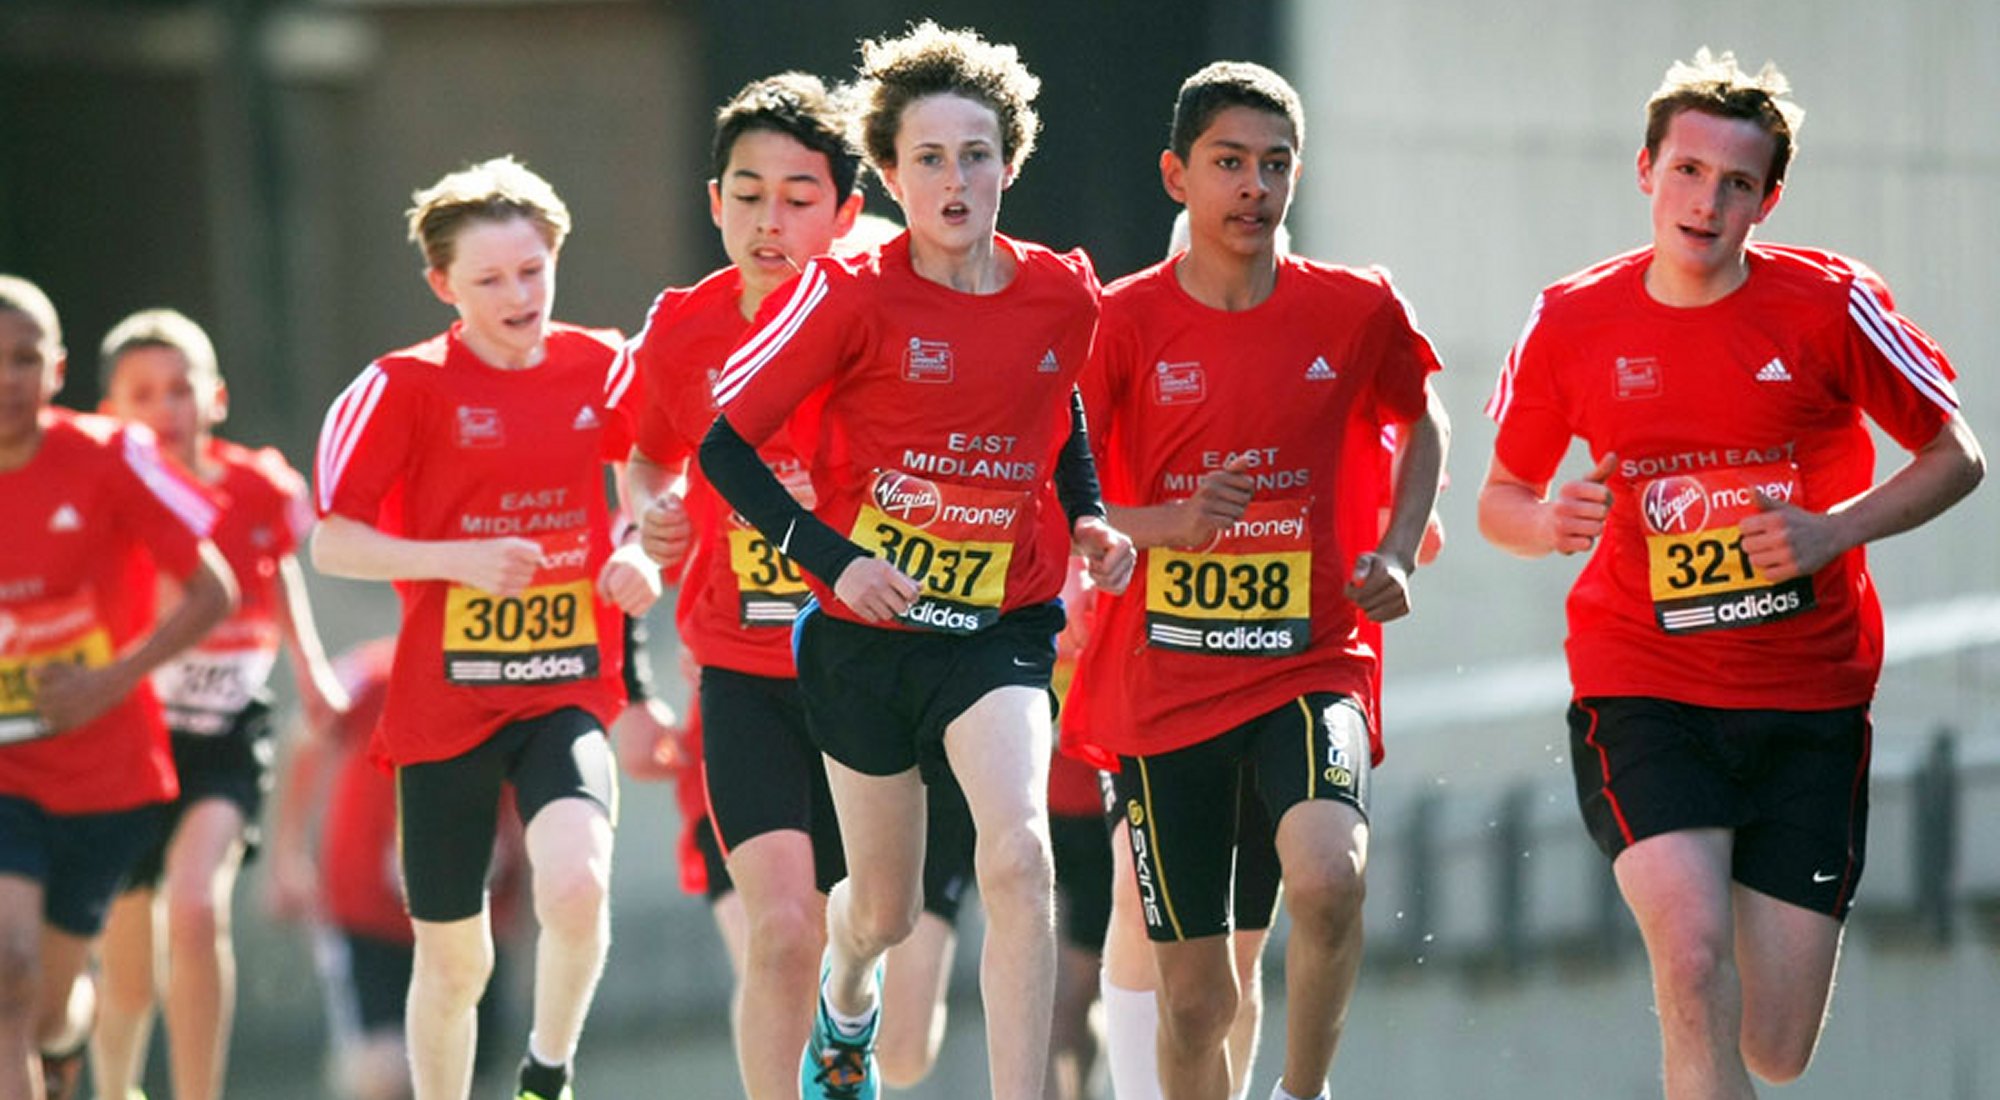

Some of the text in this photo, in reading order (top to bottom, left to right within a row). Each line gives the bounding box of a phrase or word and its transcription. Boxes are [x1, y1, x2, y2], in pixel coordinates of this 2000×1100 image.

[948, 432, 1018, 454] EAST
[1203, 447, 1280, 469] EAST
[902, 449, 1037, 481] MIDLANDS
[1621, 441, 1797, 478] SOUTH EAST
[1164, 468, 1310, 491] MINDS
[501, 487, 568, 511] EAST
[876, 474, 1017, 530] Virgin money
[1648, 480, 1794, 532] Virgin moey
[541, 546, 590, 571] oney
[876, 522, 993, 597] 3037
[1164, 560, 1290, 611] 3038
[463, 592, 577, 642] 3039
[1718, 591, 1800, 622] adidas
[1205, 626, 1293, 649] adidas
[503, 655, 585, 681] adidas
